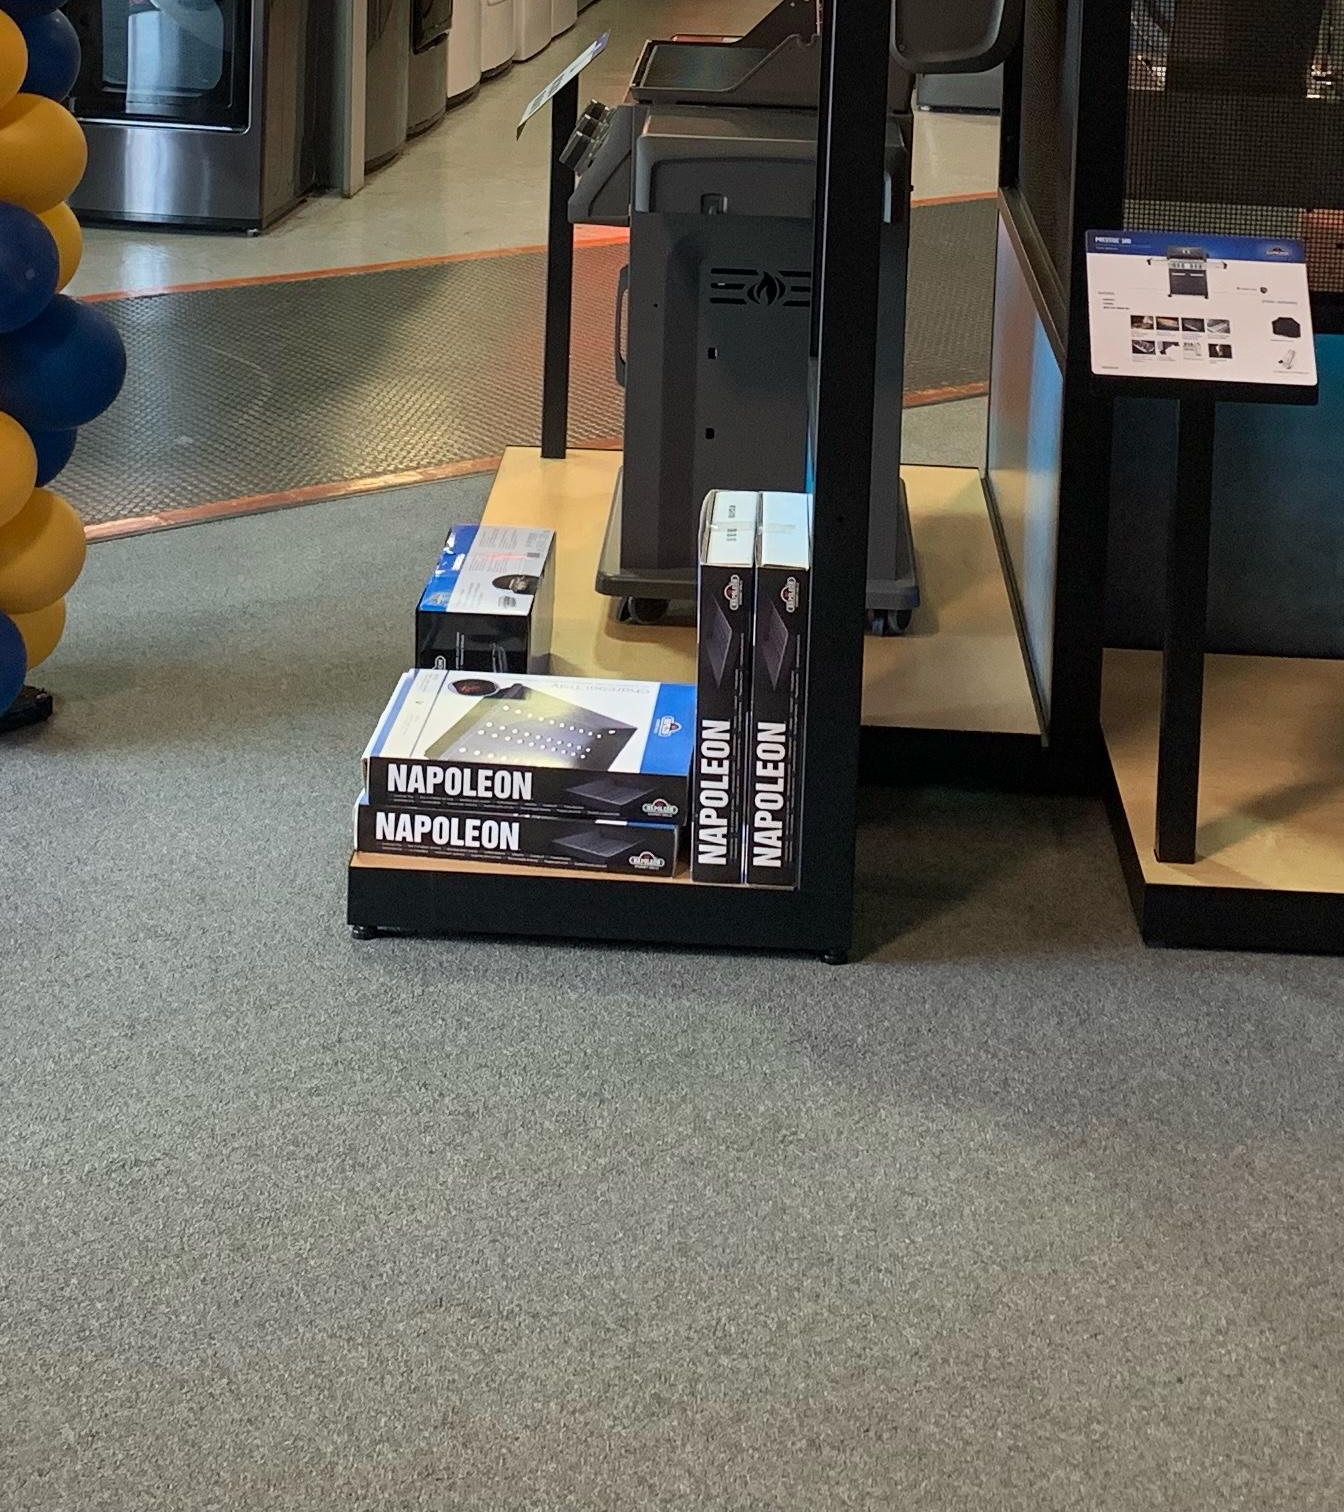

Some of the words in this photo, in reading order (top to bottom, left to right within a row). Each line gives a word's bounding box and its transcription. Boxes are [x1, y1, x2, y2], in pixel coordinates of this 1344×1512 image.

[387, 763, 533, 801] NAPOLEON
[697, 718, 731, 866] NAPOLEON
[753, 720, 787, 868] NAPOLEON
[375, 811, 521, 851] NAPOLEON
